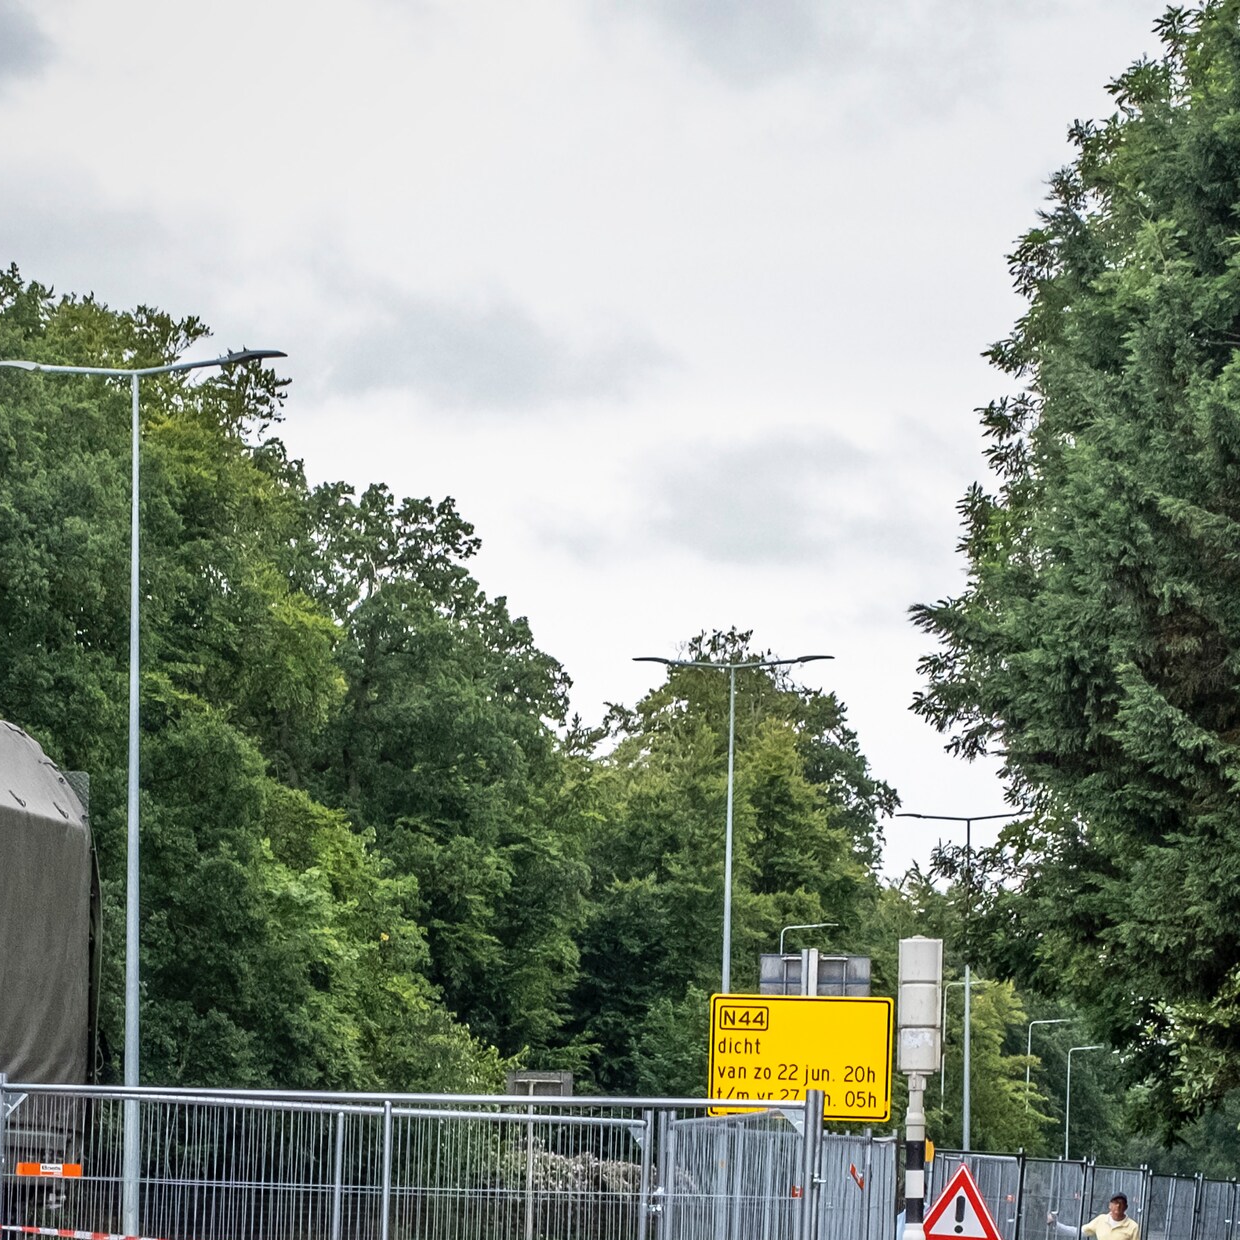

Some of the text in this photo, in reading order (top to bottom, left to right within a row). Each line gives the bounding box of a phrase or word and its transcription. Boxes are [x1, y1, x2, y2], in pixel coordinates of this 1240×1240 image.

[723, 1010, 765, 1026] N44
[717, 1037, 761, 1054] dicht
[717, 1063, 876, 1086] van zo 22 jun. 20h
[716, 1086, 750, 1100] t/m
[779, 1088, 800, 1101] 27
[844, 1090, 877, 1108] 05h
